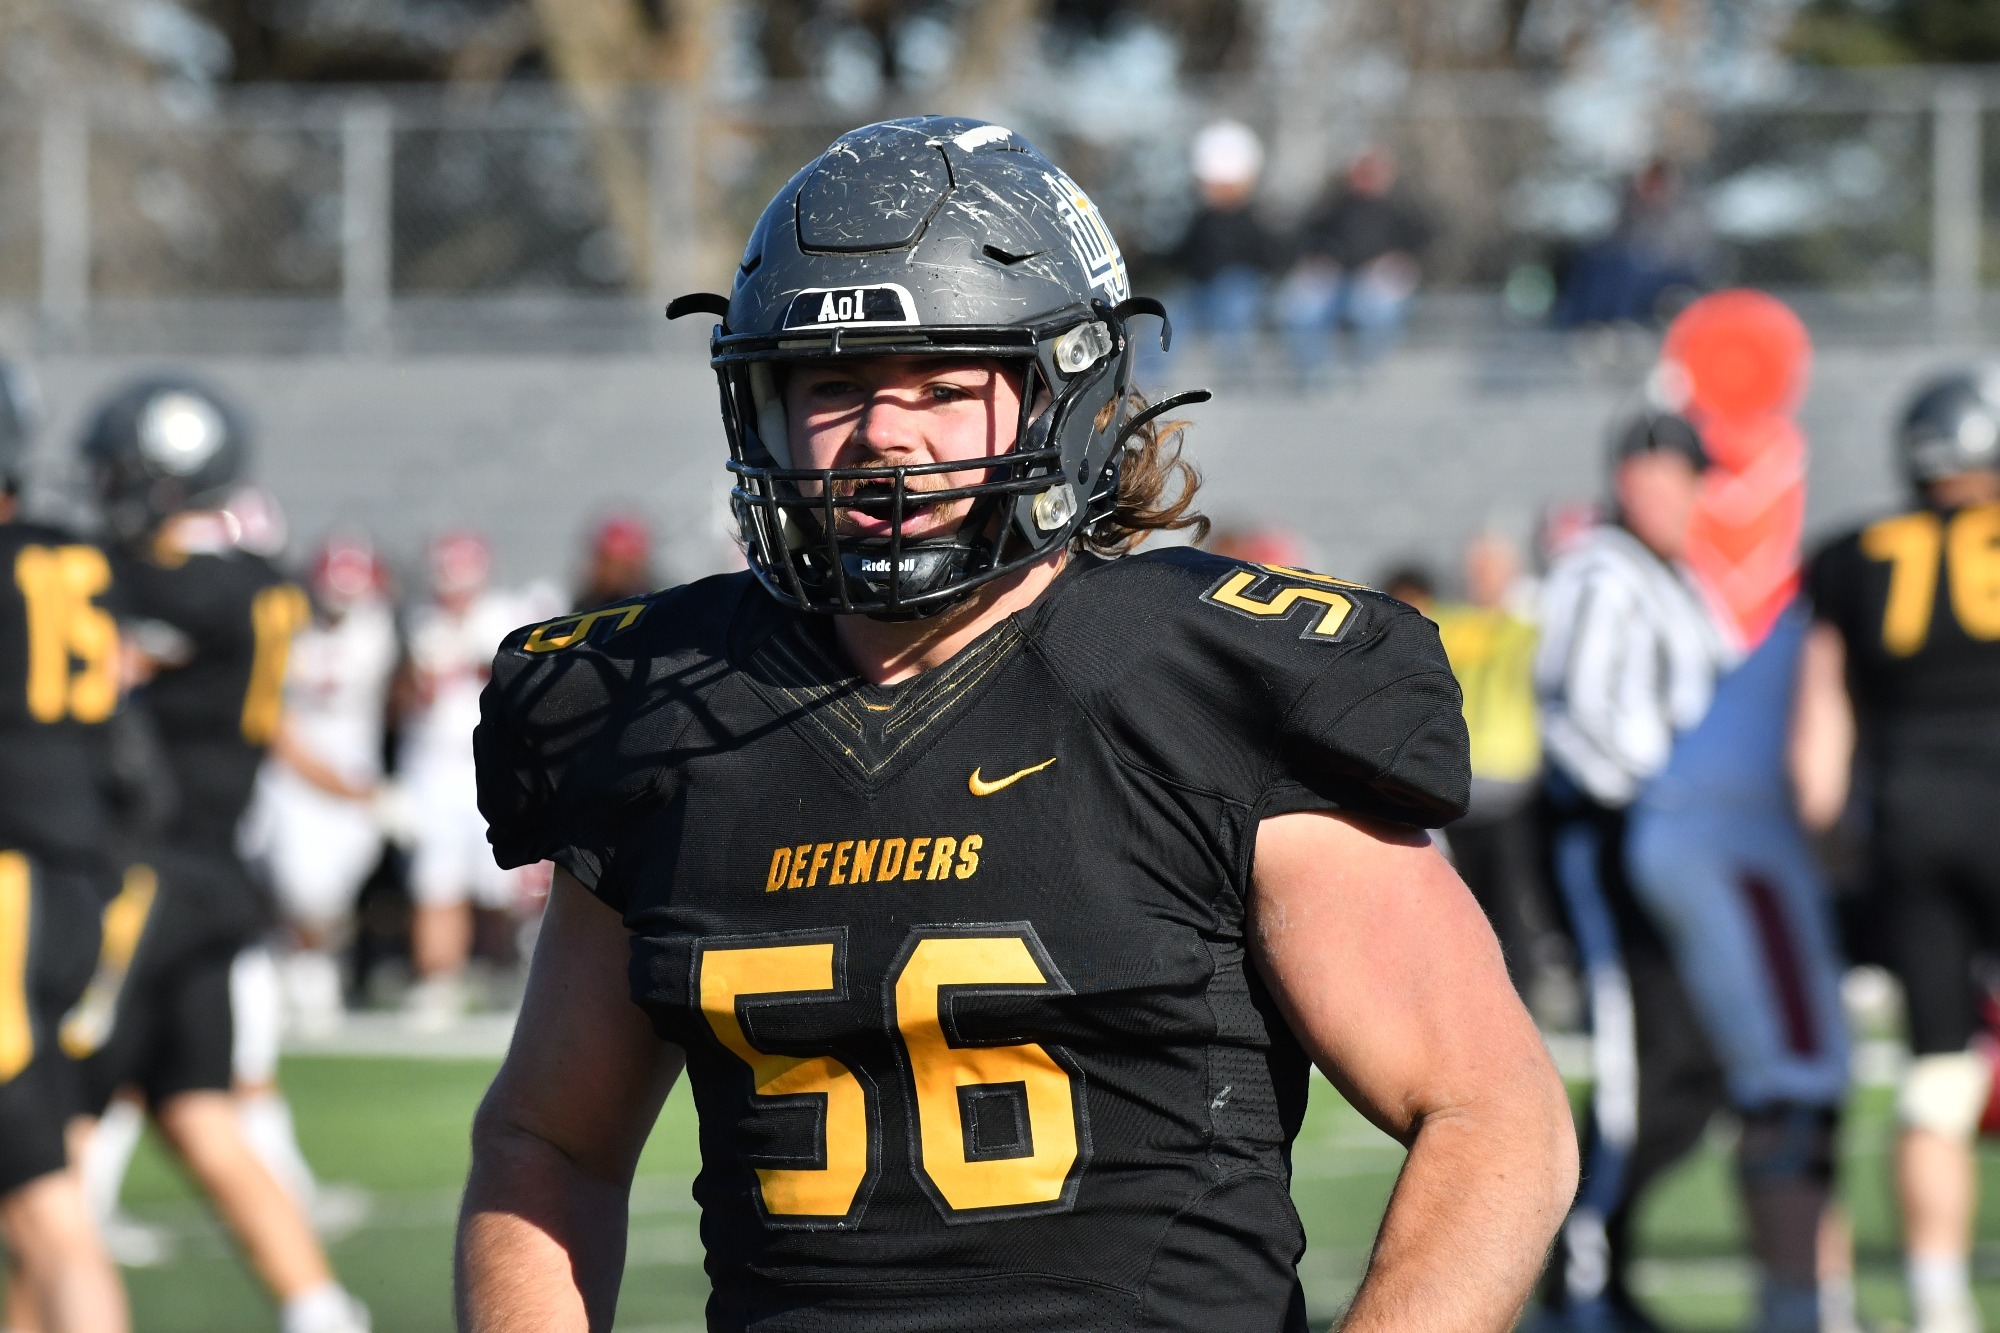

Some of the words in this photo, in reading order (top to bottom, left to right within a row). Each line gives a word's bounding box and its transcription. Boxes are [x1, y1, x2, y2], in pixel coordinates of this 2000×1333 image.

[1199, 560, 1376, 642] 5
[1859, 503, 2000, 659] 76
[765, 834, 983, 892] DEFENDERS
[693, 926, 1088, 1224] 56
